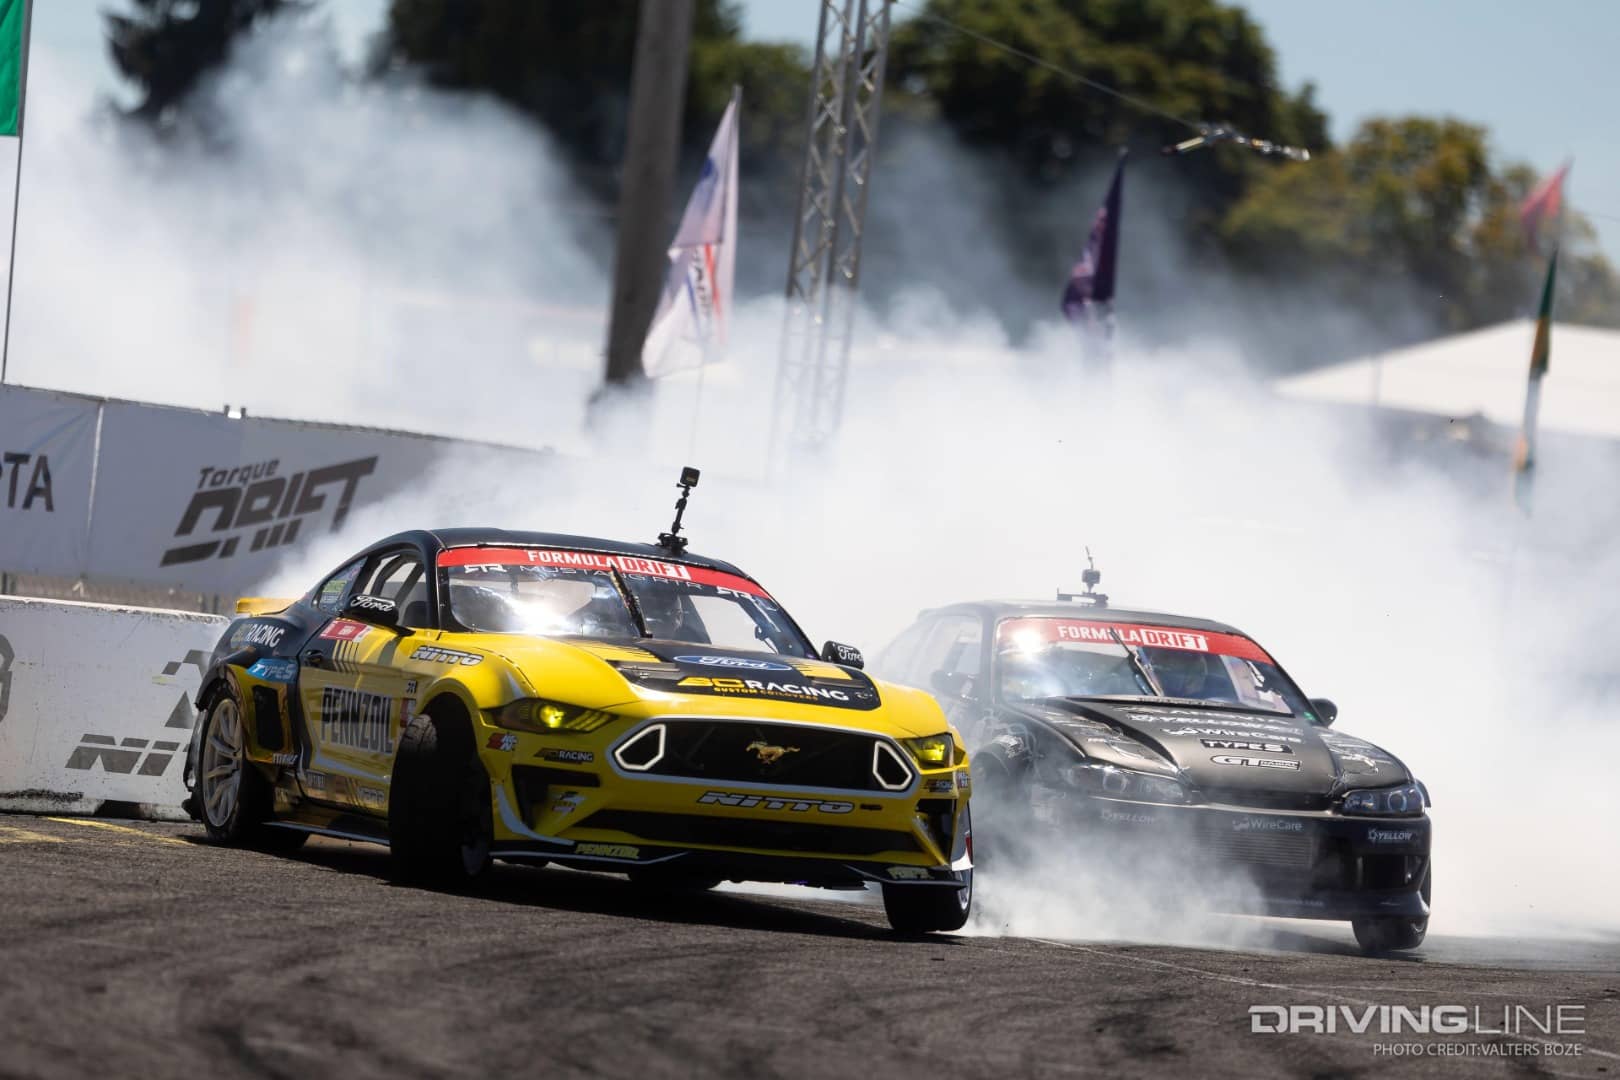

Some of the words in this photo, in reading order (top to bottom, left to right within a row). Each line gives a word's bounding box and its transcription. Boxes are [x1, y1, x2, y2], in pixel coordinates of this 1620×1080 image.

[0, 452, 54, 512] TA
[198, 459, 280, 489] Torque
[527, 551, 618, 569] FORMULA
[618, 556, 692, 580] DRIFT
[350, 595, 396, 612] Ford
[1141, 630, 1208, 652] DRIFT
[410, 646, 484, 666] NITTO
[698, 656, 770, 669] Ford
[744, 680, 849, 701] RACING
[321, 686, 394, 755] PENNZOIL
[559, 750, 594, 761] RACING
[697, 791, 855, 814] NITTO
[1250, 818, 1303, 832] WireCare
[1378, 830, 1413, 841] YELLOW
